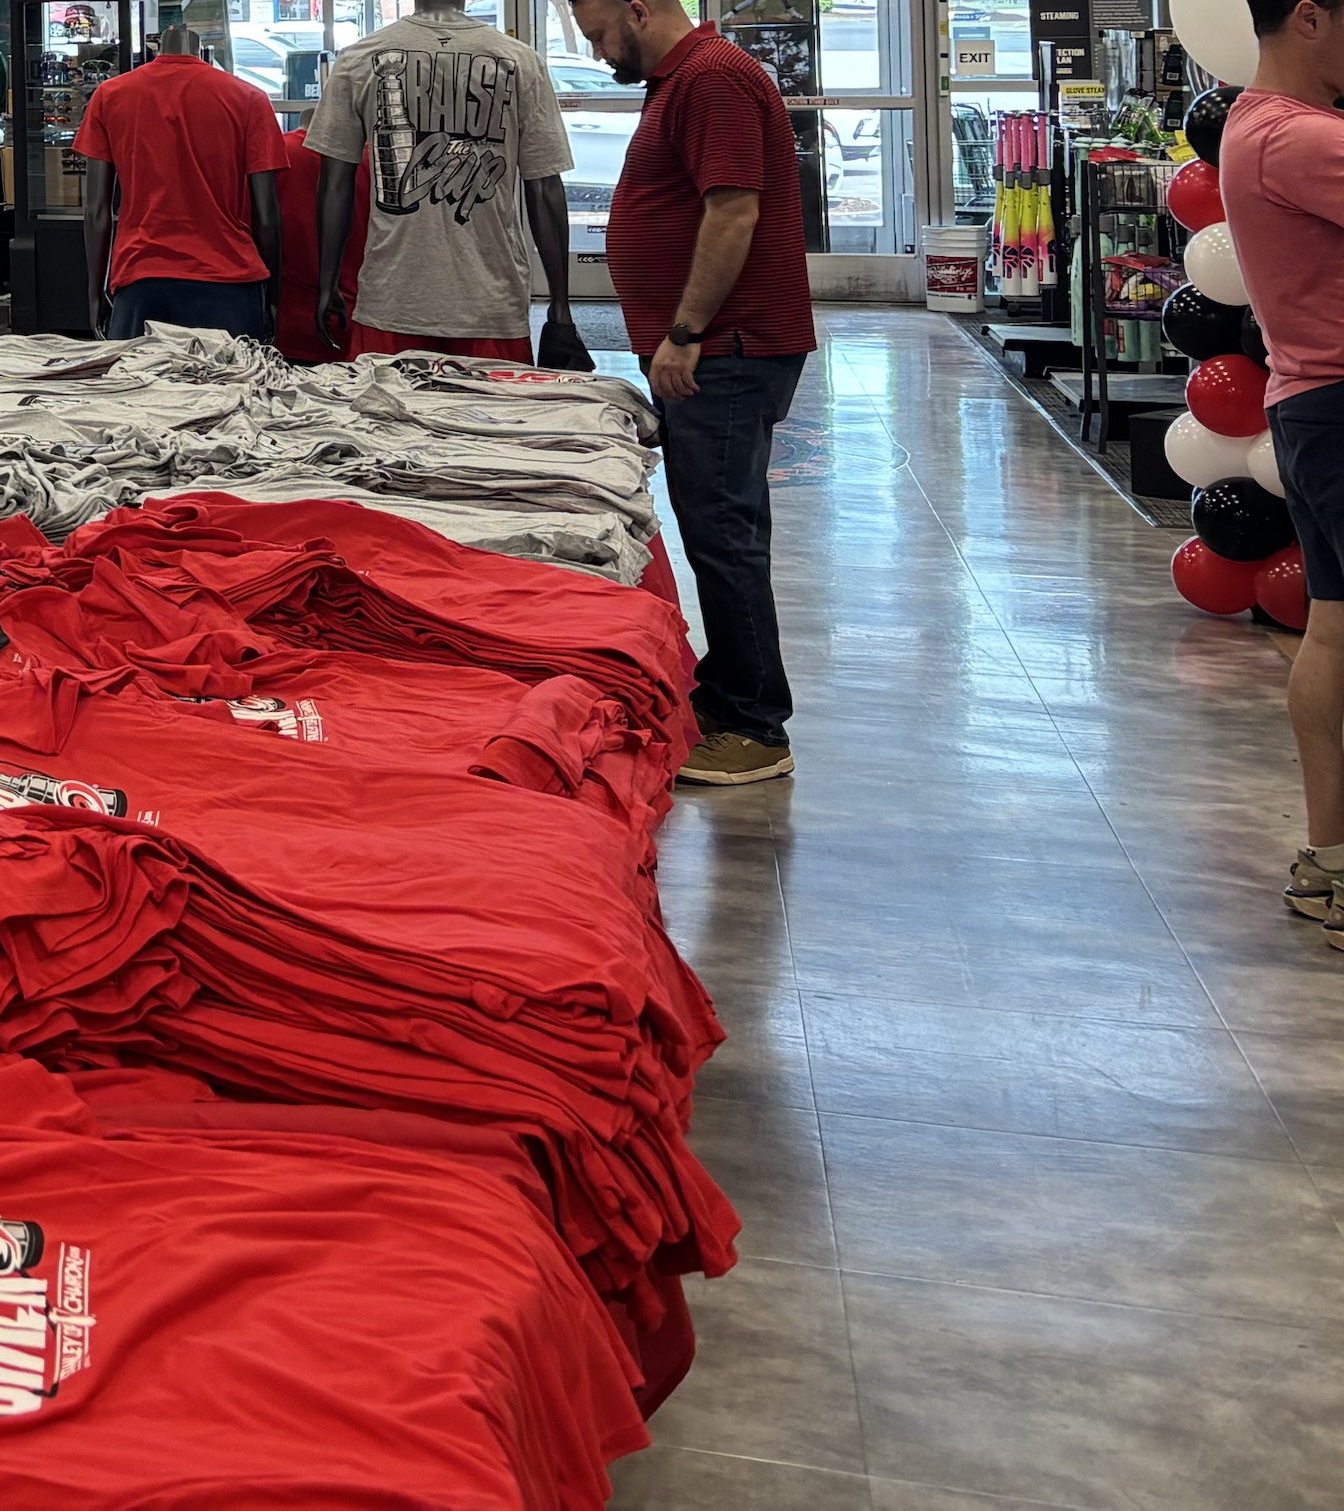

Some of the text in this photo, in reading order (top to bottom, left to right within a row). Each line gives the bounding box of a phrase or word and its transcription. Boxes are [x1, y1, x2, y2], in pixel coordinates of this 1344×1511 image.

[1039, 11, 1080, 21] STEAMING
[959, 52, 991, 63] EXIT
[1056, 56, 1072, 65] LAN
[406, 49, 517, 144] RAISE
[446, 139, 471, 156] The
[398, 133, 507, 226] Cup
